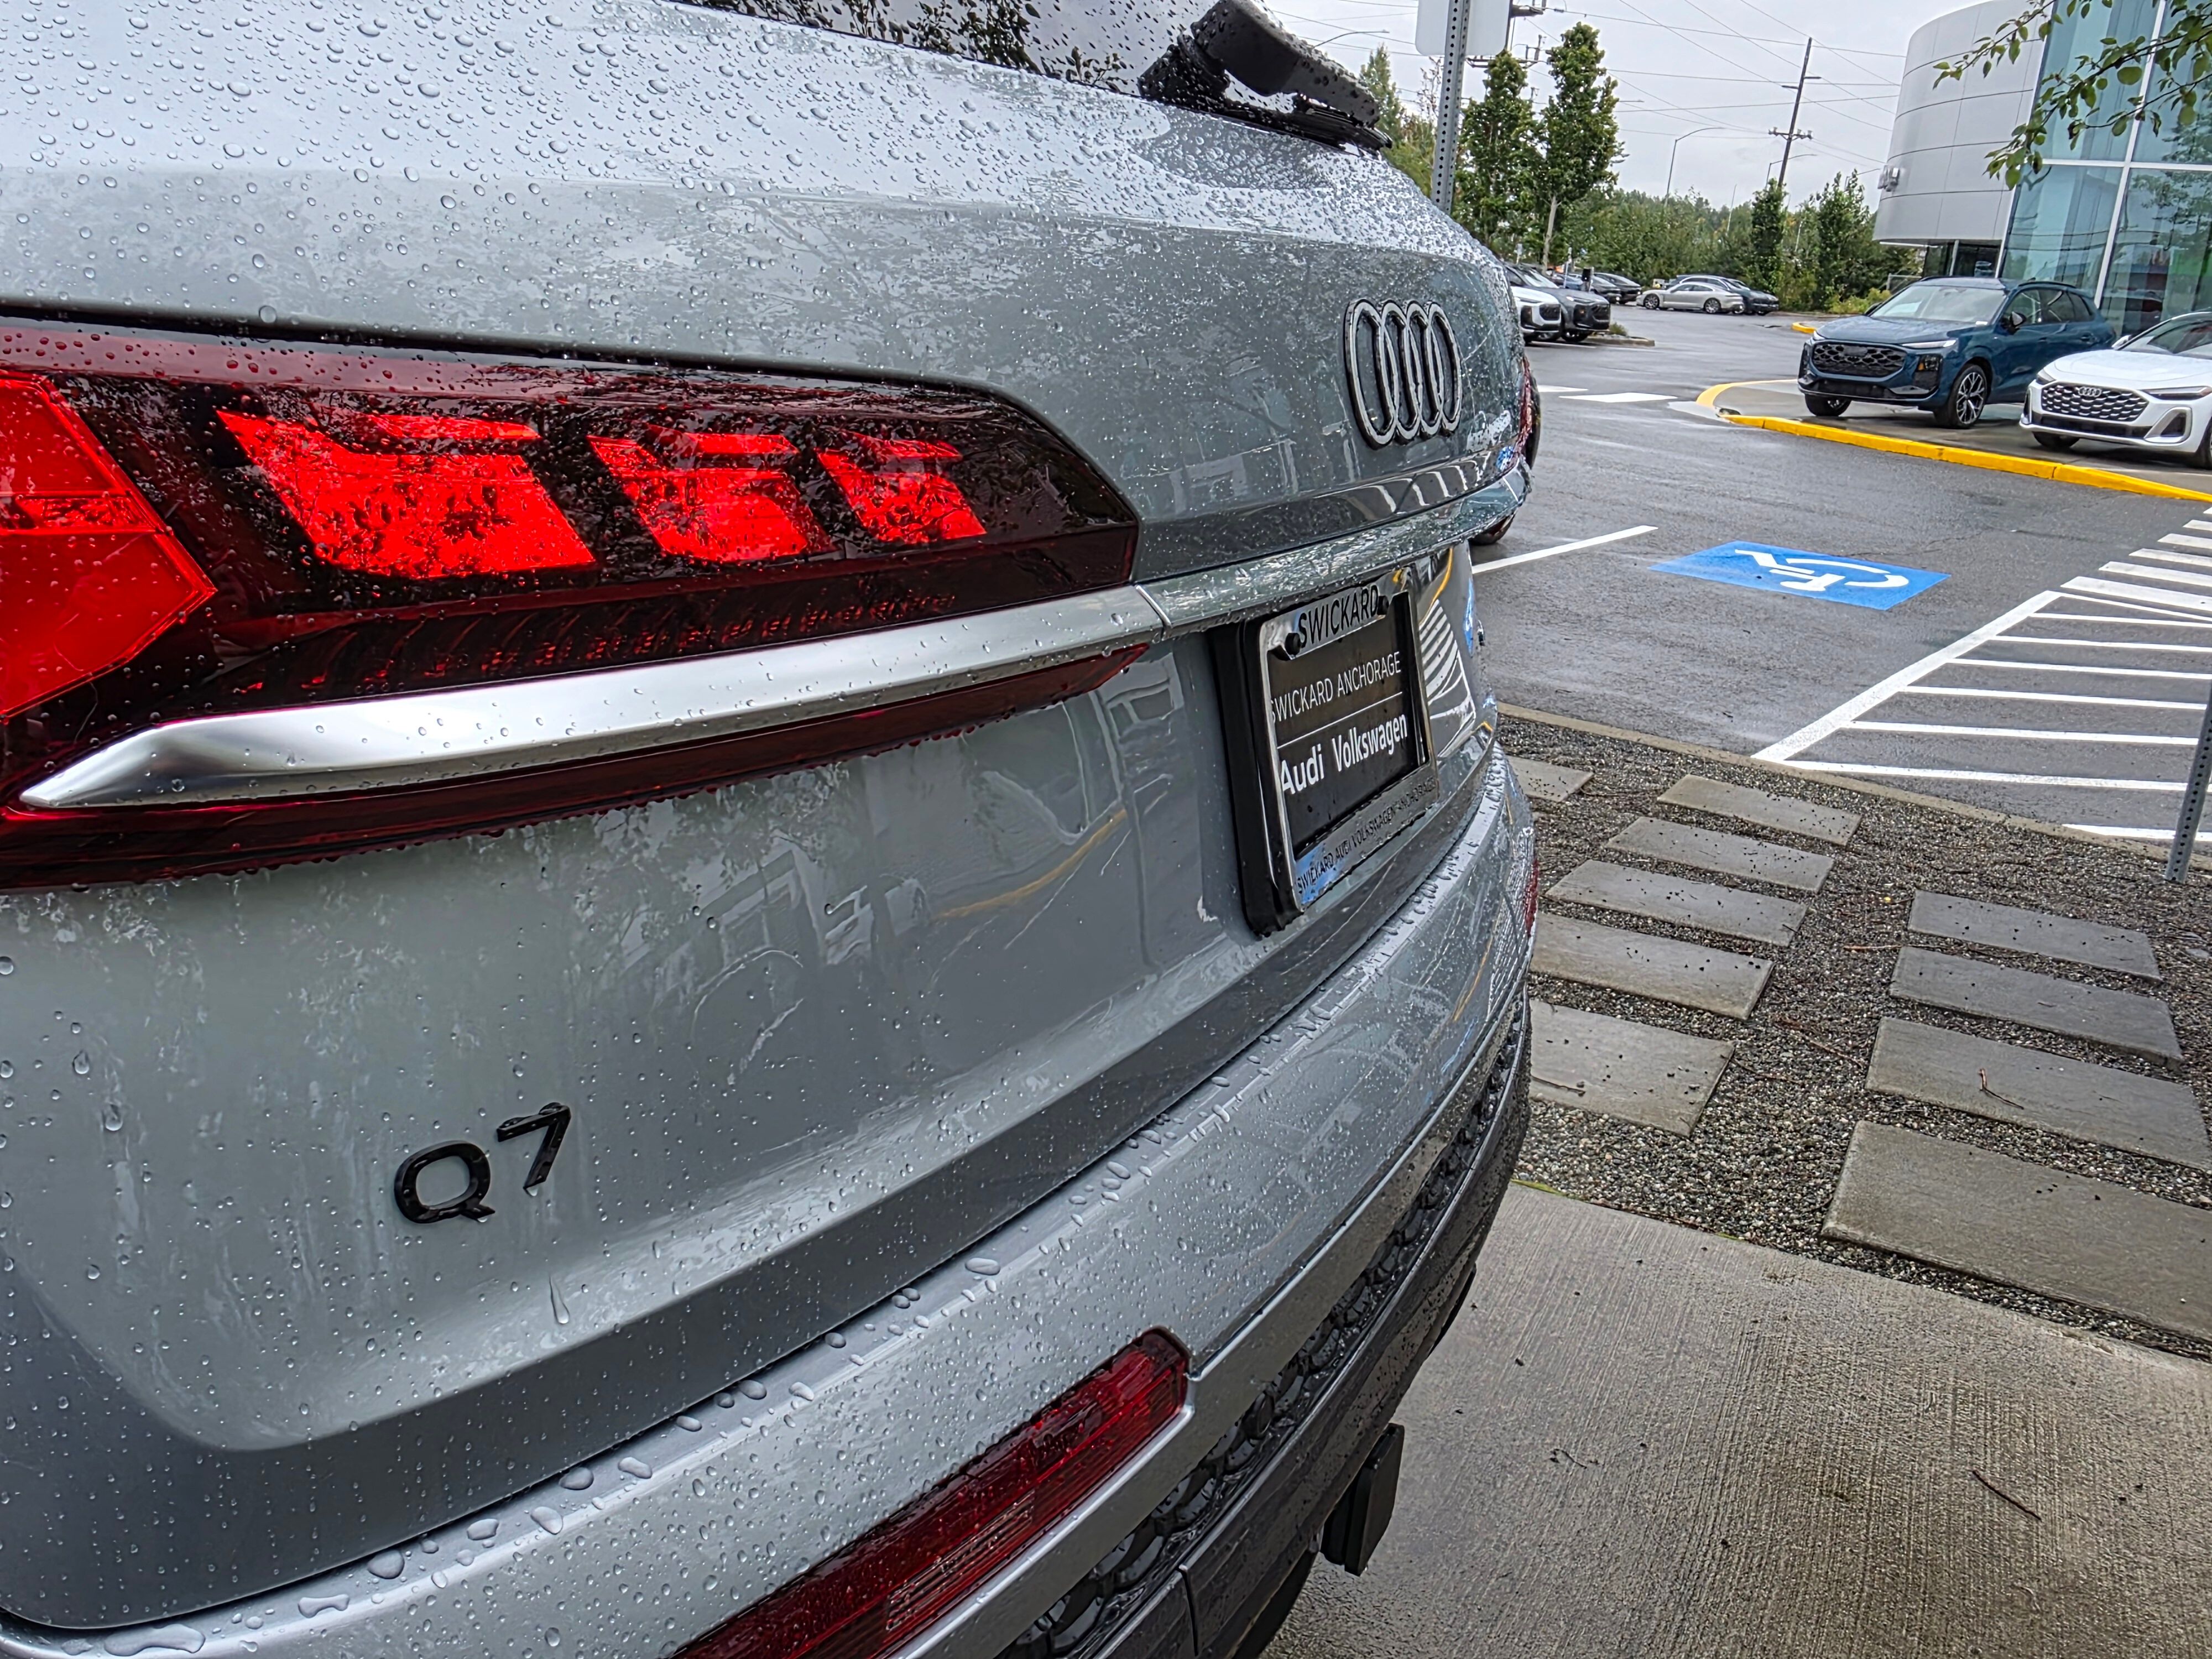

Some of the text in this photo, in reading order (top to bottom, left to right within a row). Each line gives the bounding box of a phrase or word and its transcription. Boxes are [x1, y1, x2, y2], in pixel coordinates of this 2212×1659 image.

[1298, 585, 1379, 648] SWICKARD
[1338, 651, 1401, 697] ANCHORAGE
[1281, 714, 1407, 795] Audi Volkswagen
[394, 1103, 571, 1224] Q7
